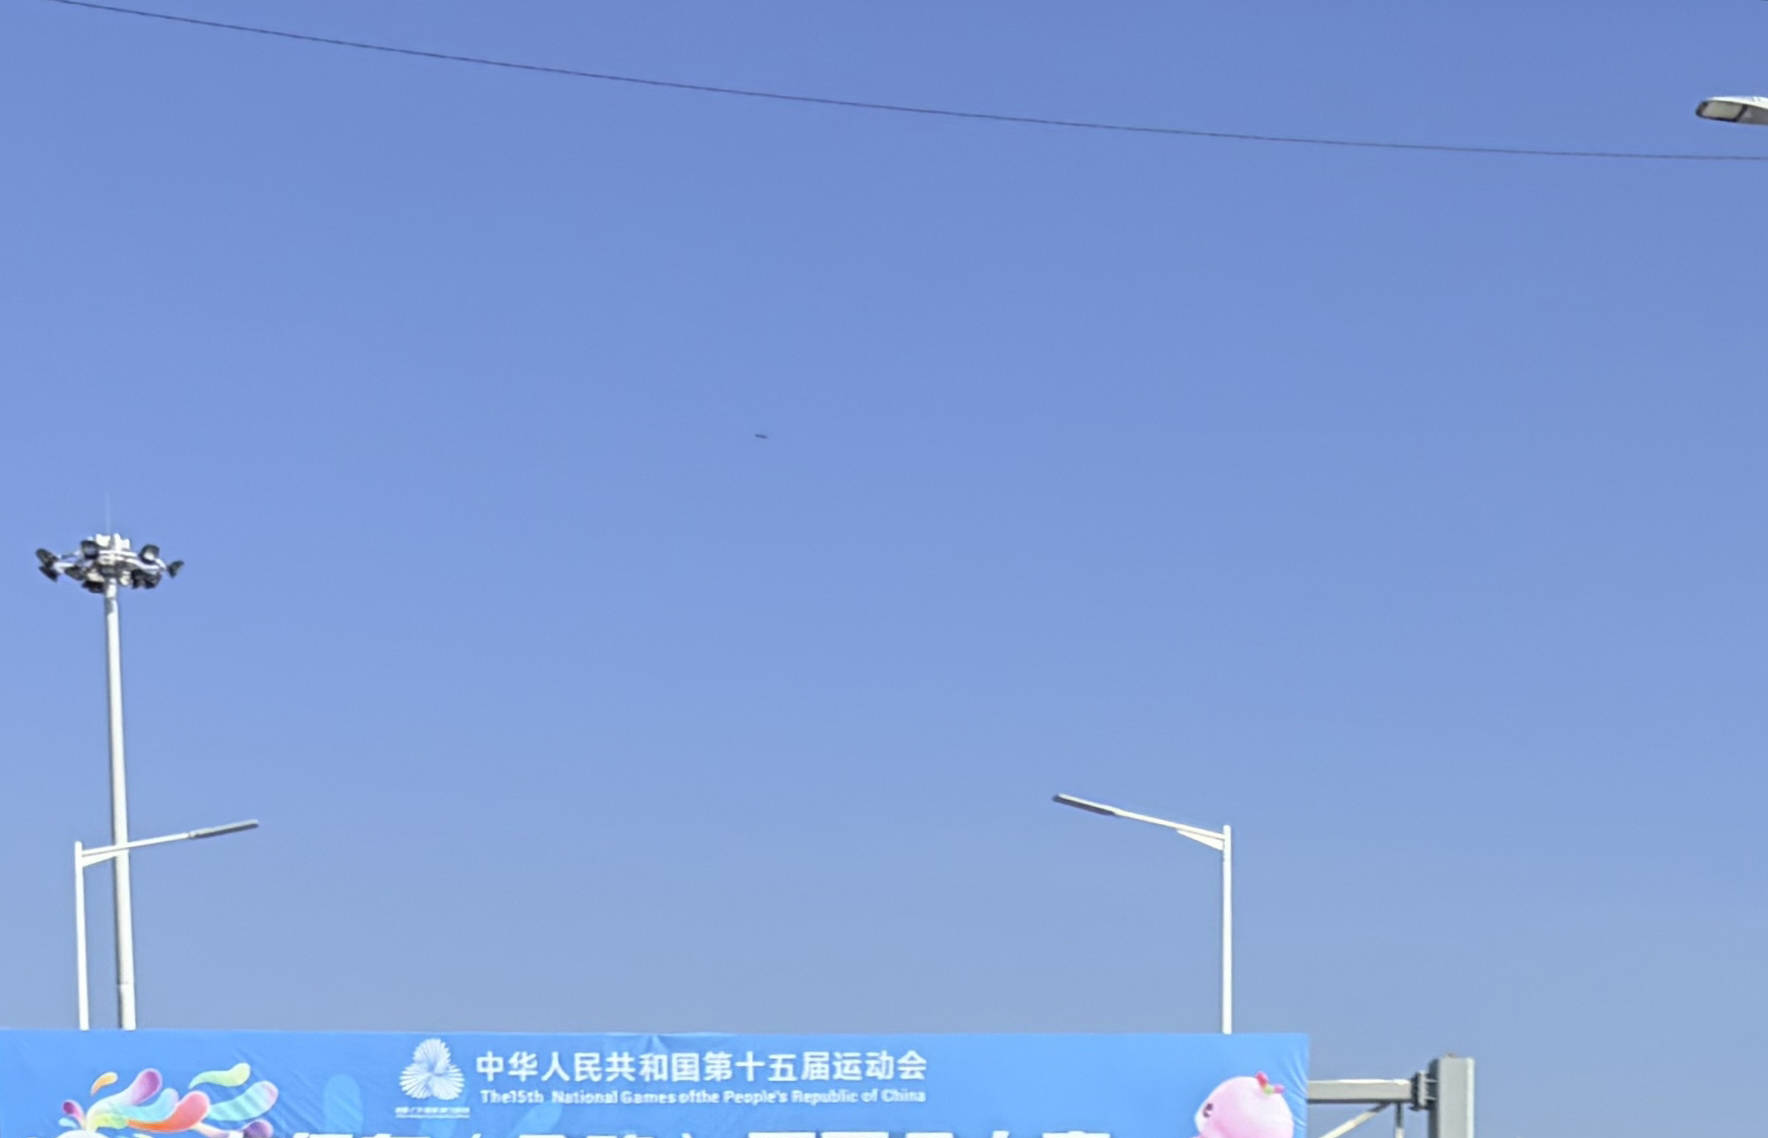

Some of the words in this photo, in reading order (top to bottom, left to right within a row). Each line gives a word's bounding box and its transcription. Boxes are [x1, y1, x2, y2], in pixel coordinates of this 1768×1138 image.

[476, 1050, 927, 1083] 中华人民共和国第十五届运动会
[551, 1090, 618, 1104] National
[621, 1090, 676, 1105] Games
[722, 1089, 788, 1106] People's
[791, 1089, 858, 1106] Republic
[861, 1088, 878, 1103] of
[881, 1088, 927, 1103] China
